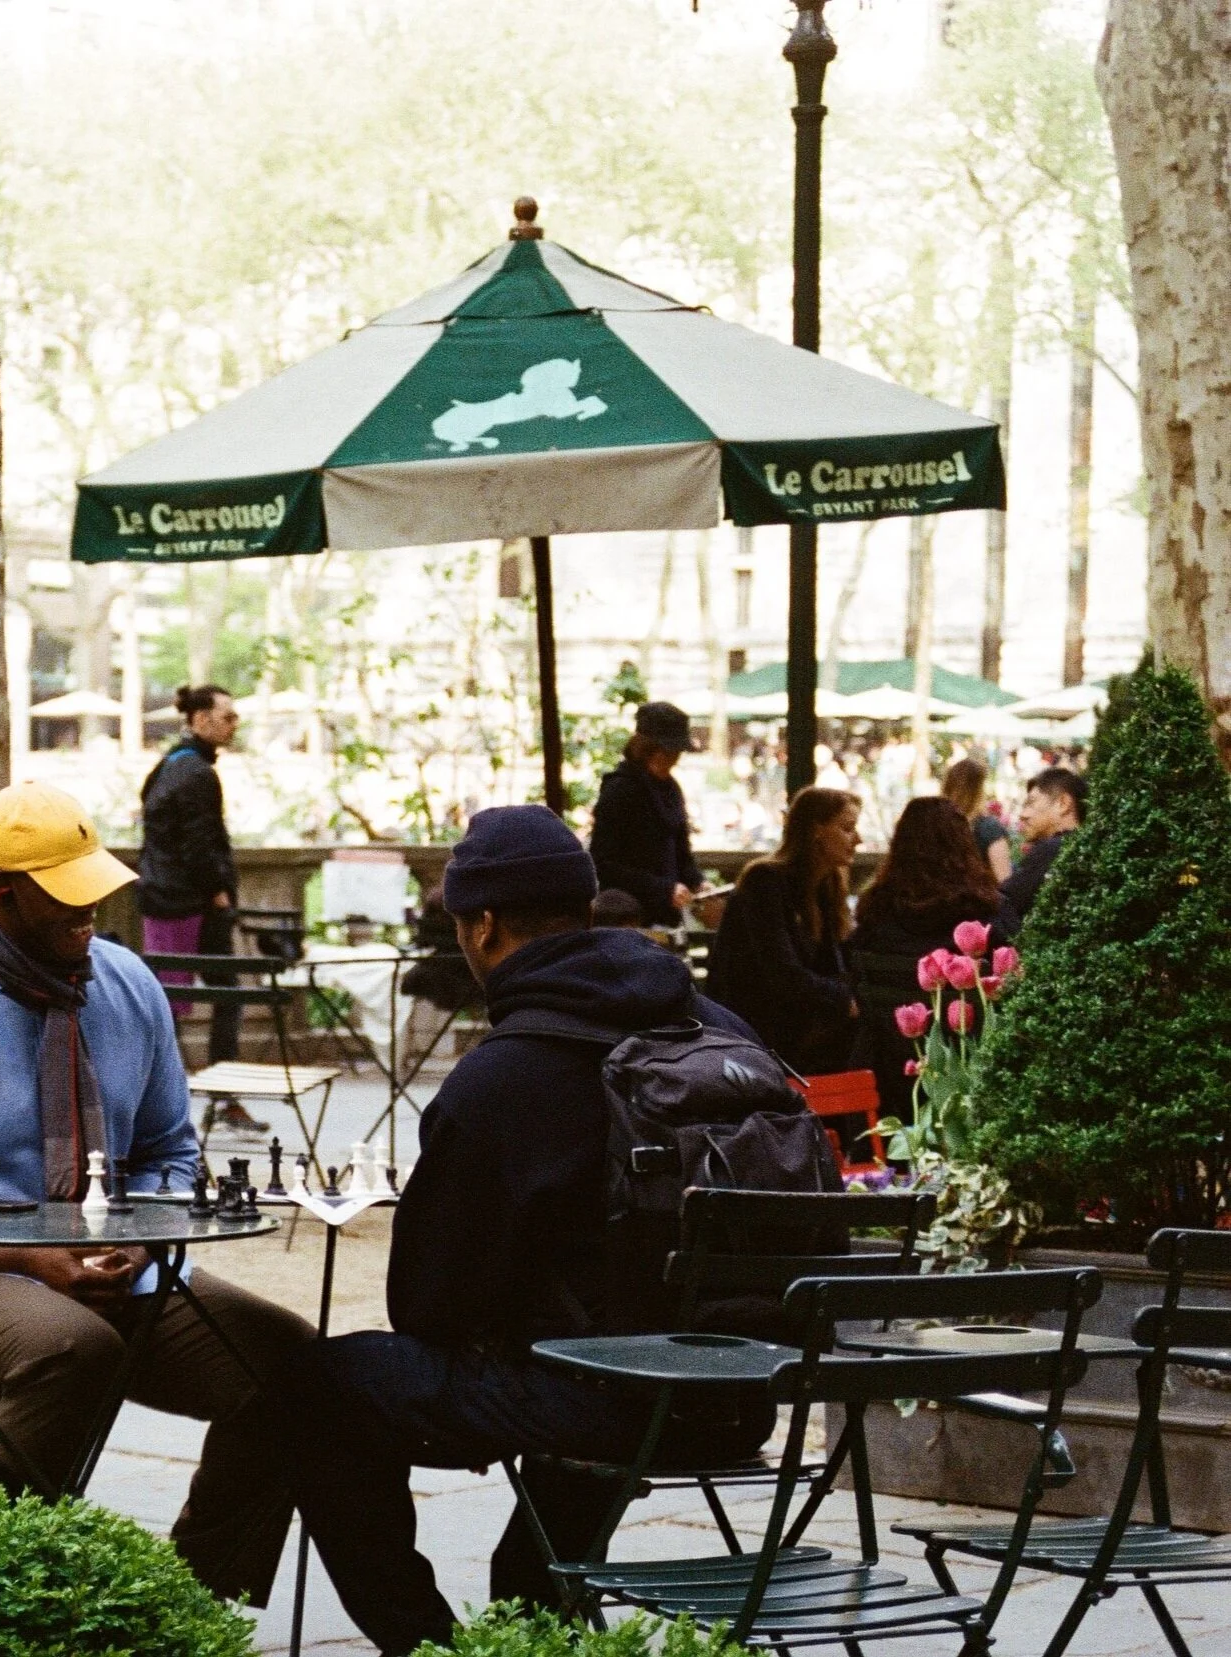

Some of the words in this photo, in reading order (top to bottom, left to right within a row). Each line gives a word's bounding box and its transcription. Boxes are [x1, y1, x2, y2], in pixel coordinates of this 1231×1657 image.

[764, 462, 802, 496] Le
[810, 450, 973, 494] Carrousel
[112, 505, 145, 535] Le
[150, 494, 285, 535] Carrousel
[813, 499, 875, 516] BRYANT
[881, 496, 920, 512] PARK
